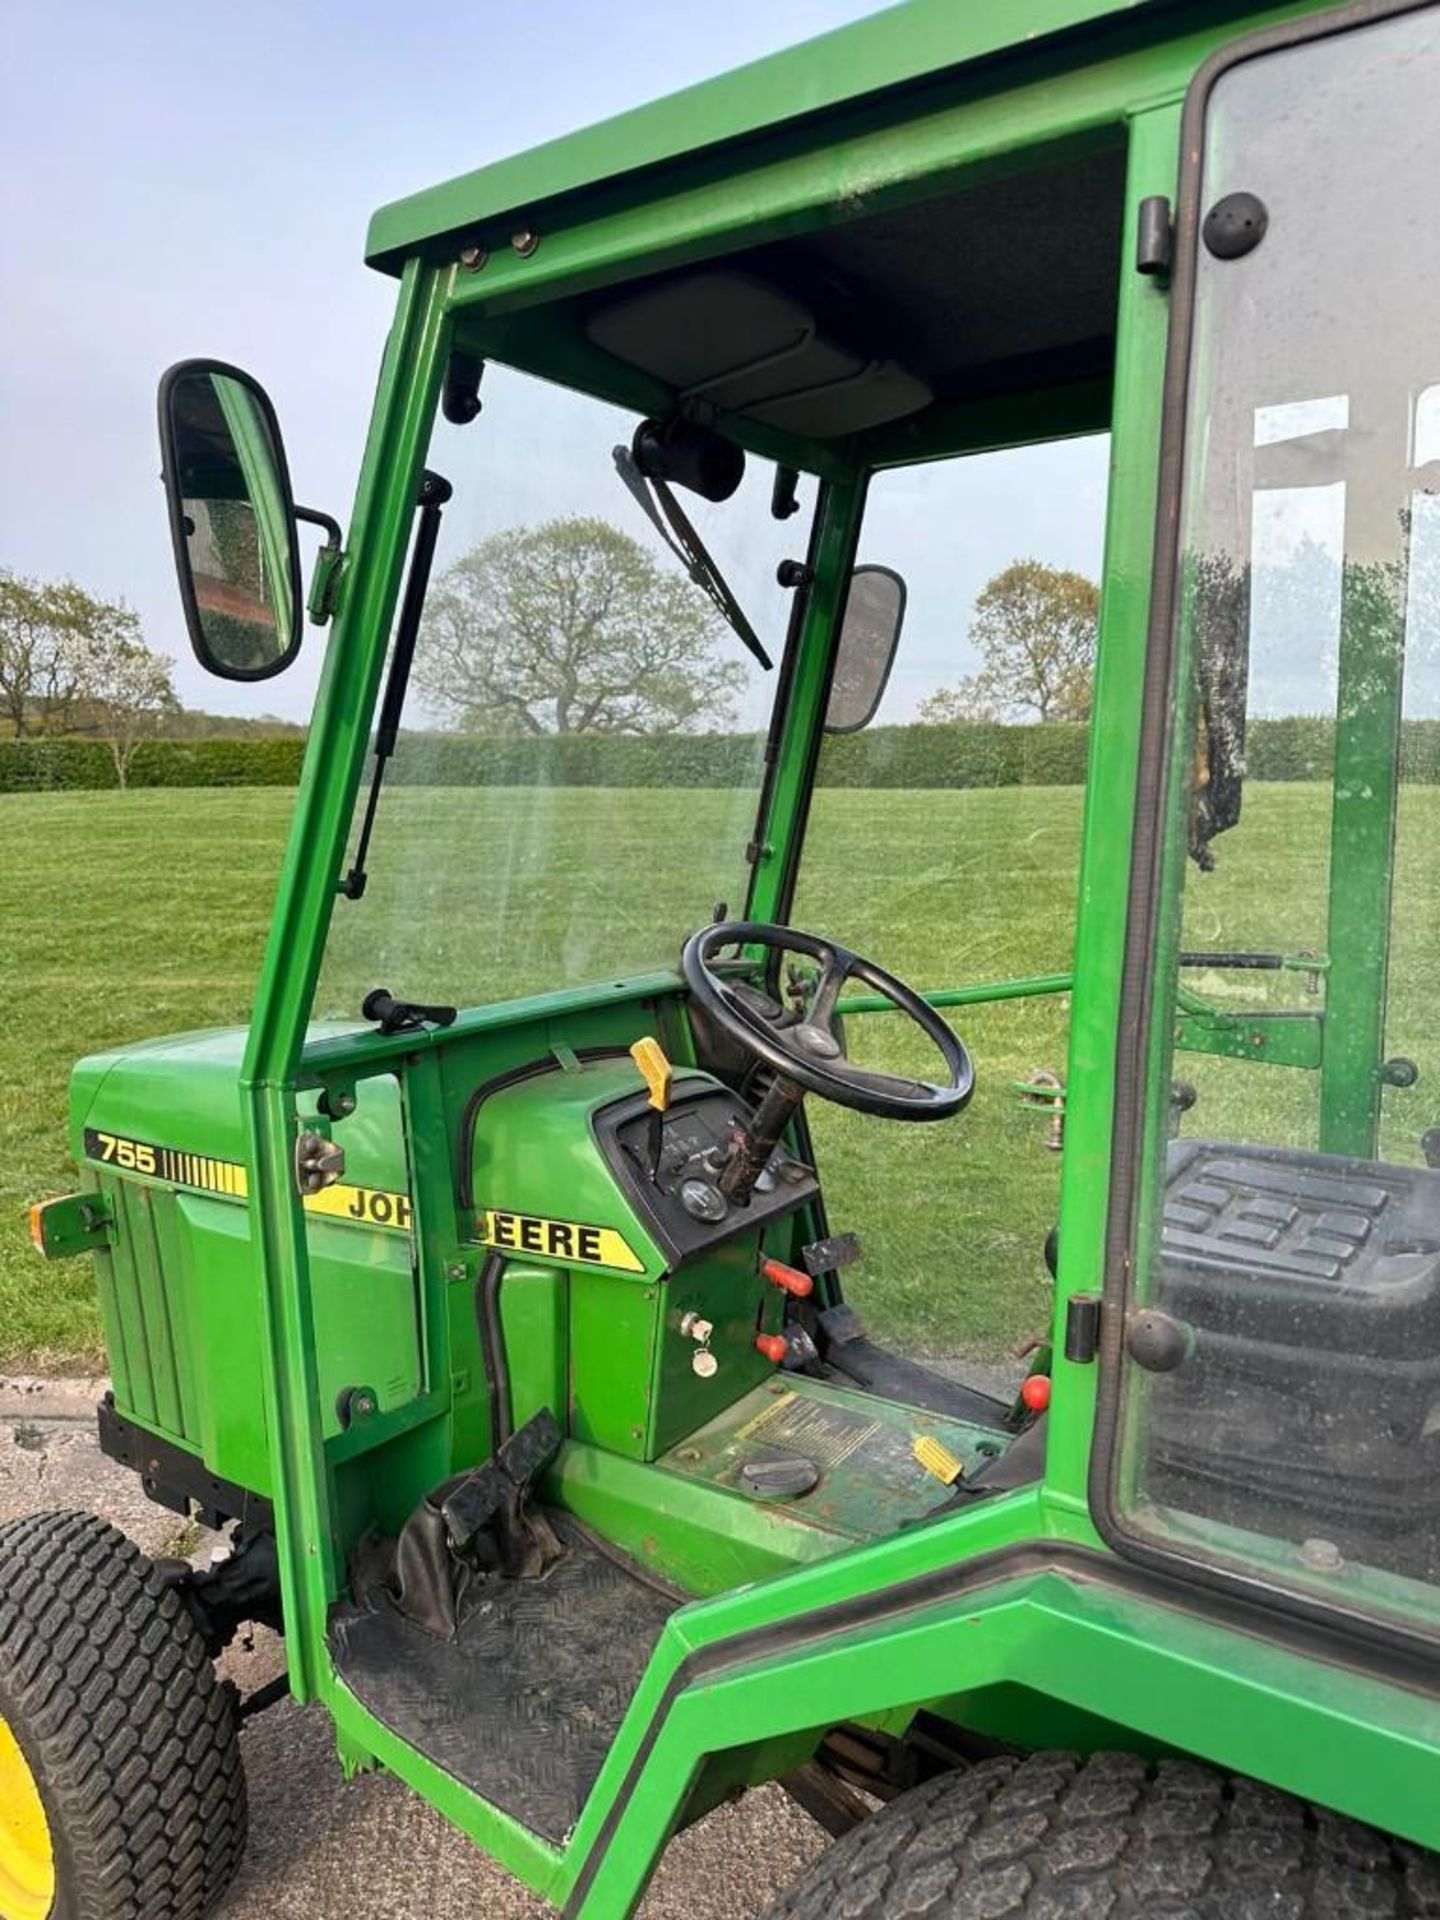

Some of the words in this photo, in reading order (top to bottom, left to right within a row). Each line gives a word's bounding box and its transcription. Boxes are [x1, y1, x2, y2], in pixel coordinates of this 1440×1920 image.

[97, 1133, 156, 1174] 755
[348, 1190, 411, 1226] JOH
[493, 1212, 602, 1262] EERE
